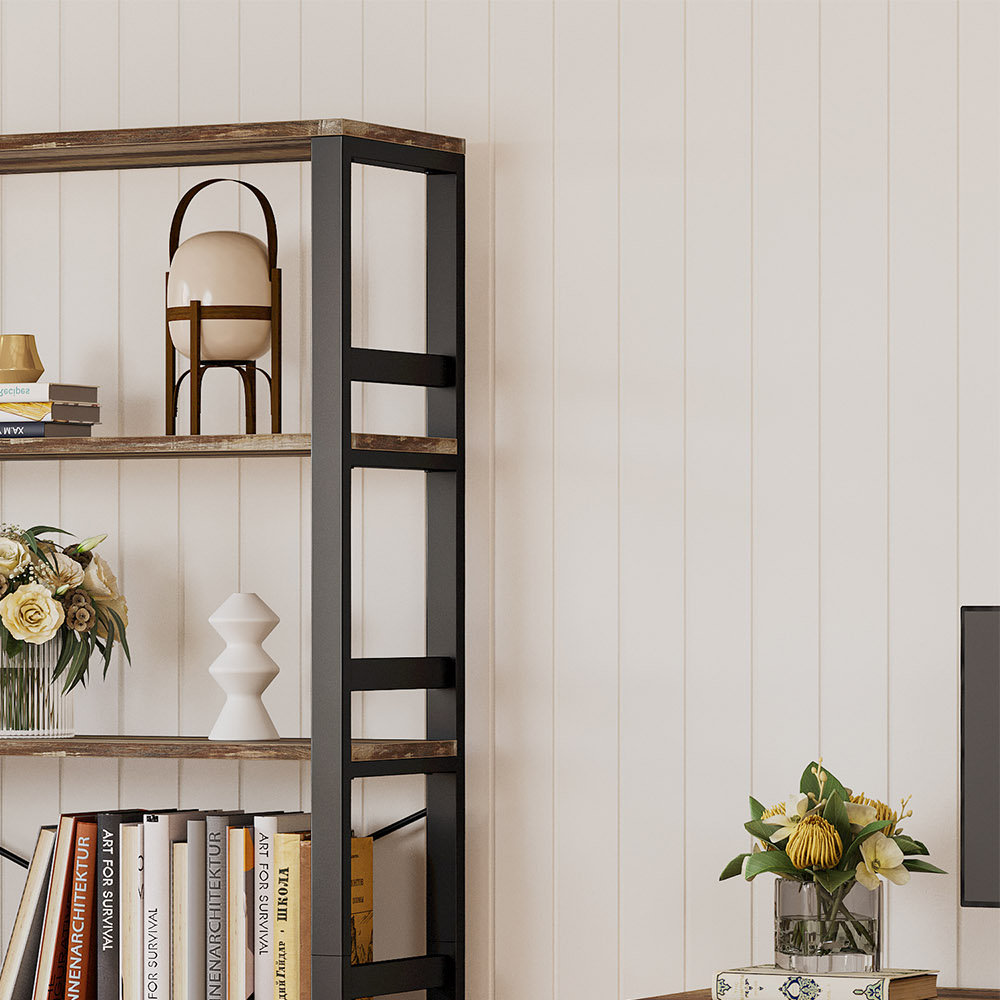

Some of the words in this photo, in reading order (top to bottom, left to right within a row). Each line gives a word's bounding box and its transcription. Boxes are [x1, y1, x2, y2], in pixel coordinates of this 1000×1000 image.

[102, 828, 114, 855] ART
[258, 832, 269, 858] ART
[102, 859, 114, 887] FOR
[258, 863, 269, 890] FOR
[276, 866, 290, 922] ШКОЛА
[102, 890, 114, 952] SURVIVAL
[258, 894, 269, 956] SURVIVAL
[147, 908, 158, 968] SURVIVAL
[147, 972, 158, 1000] FOR
